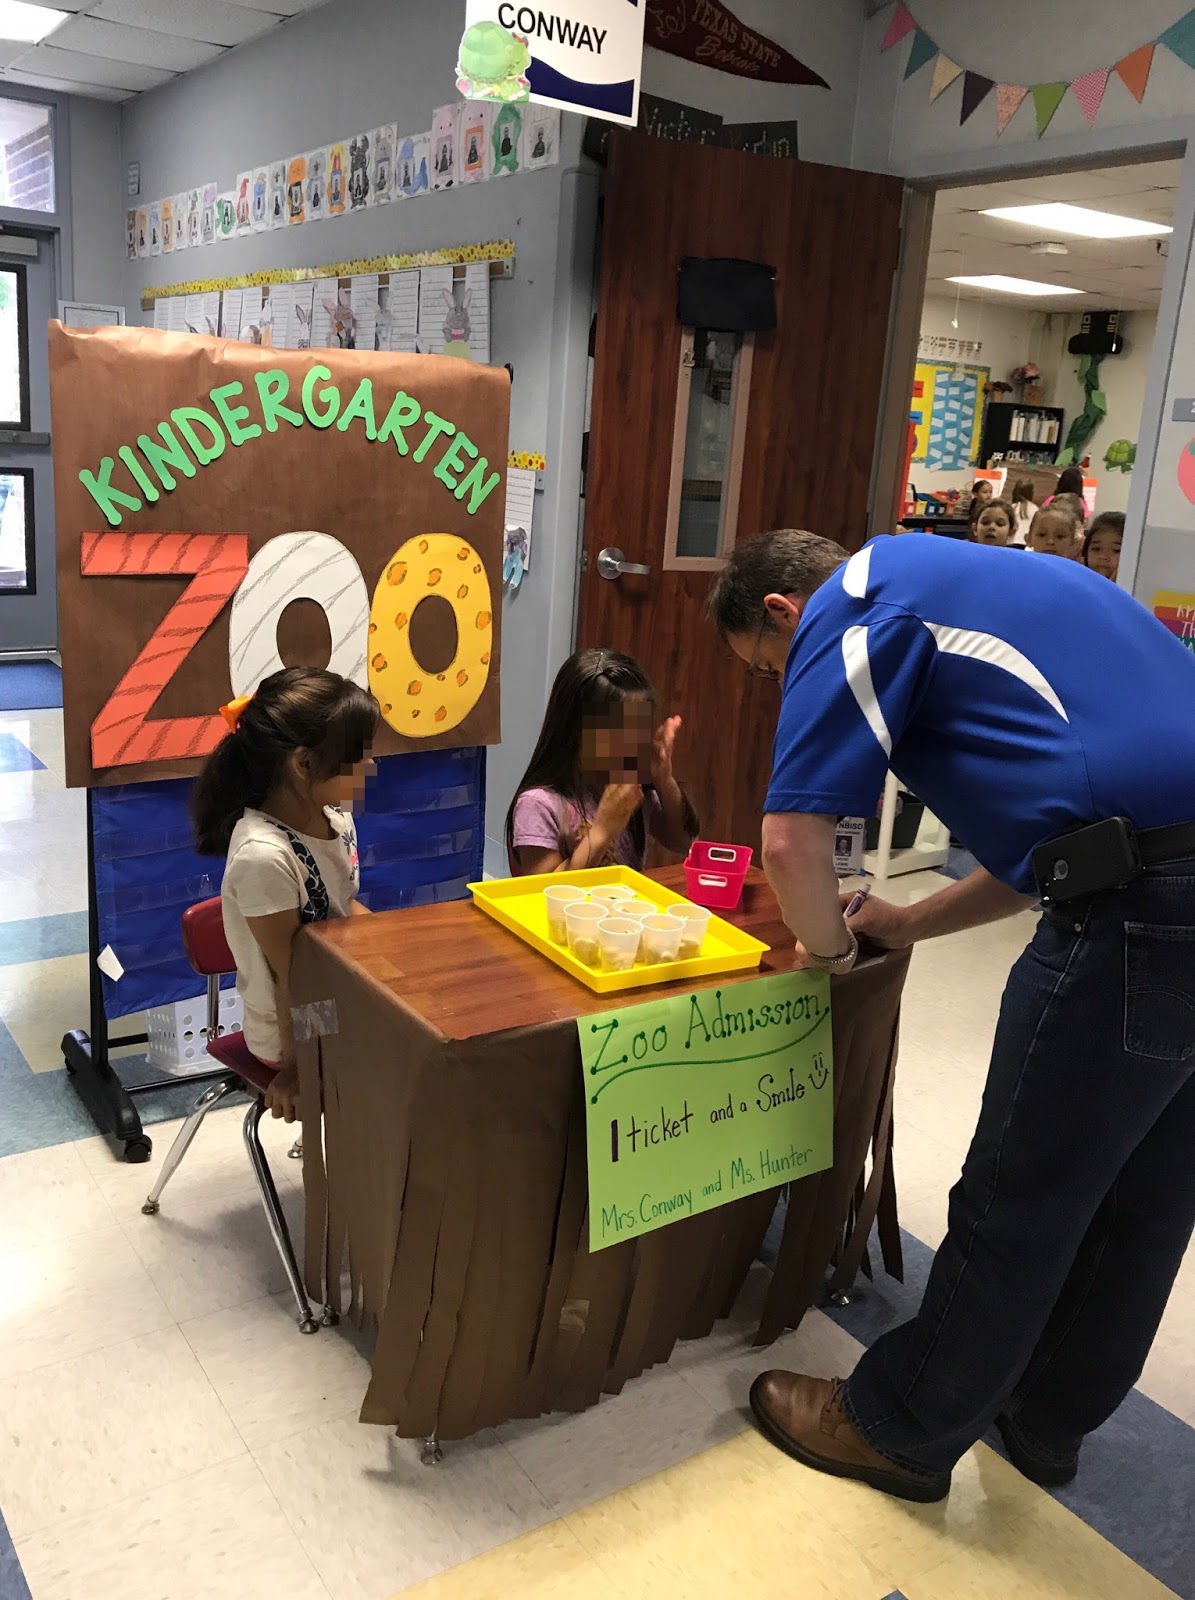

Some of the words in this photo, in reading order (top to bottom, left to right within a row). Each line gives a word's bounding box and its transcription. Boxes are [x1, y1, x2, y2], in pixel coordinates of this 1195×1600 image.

[498, 2, 607, 54] CONWAY
[691, 0, 738, 43] TEXAS
[740, 31, 781, 68] STATE
[79, 365, 500, 525] KINDERGARTEN
[81, 530, 492, 768] ZOO
[838, 822, 864, 830] NBISD
[591, 1019, 668, 1075] Zoo
[684, 990, 821, 1048] Admission
[626, 1100, 694, 1152] ticket
[710, 1093, 734, 1124] and
[740, 1101, 748, 1113] a
[756, 1067, 806, 1112] Smile
[601, 1205, 638, 1238] Mrs.
[639, 1189, 692, 1223] Conway
[702, 1170, 723, 1197] and
[730, 1157, 756, 1190] Ms.
[759, 1144, 813, 1180] Hunter
